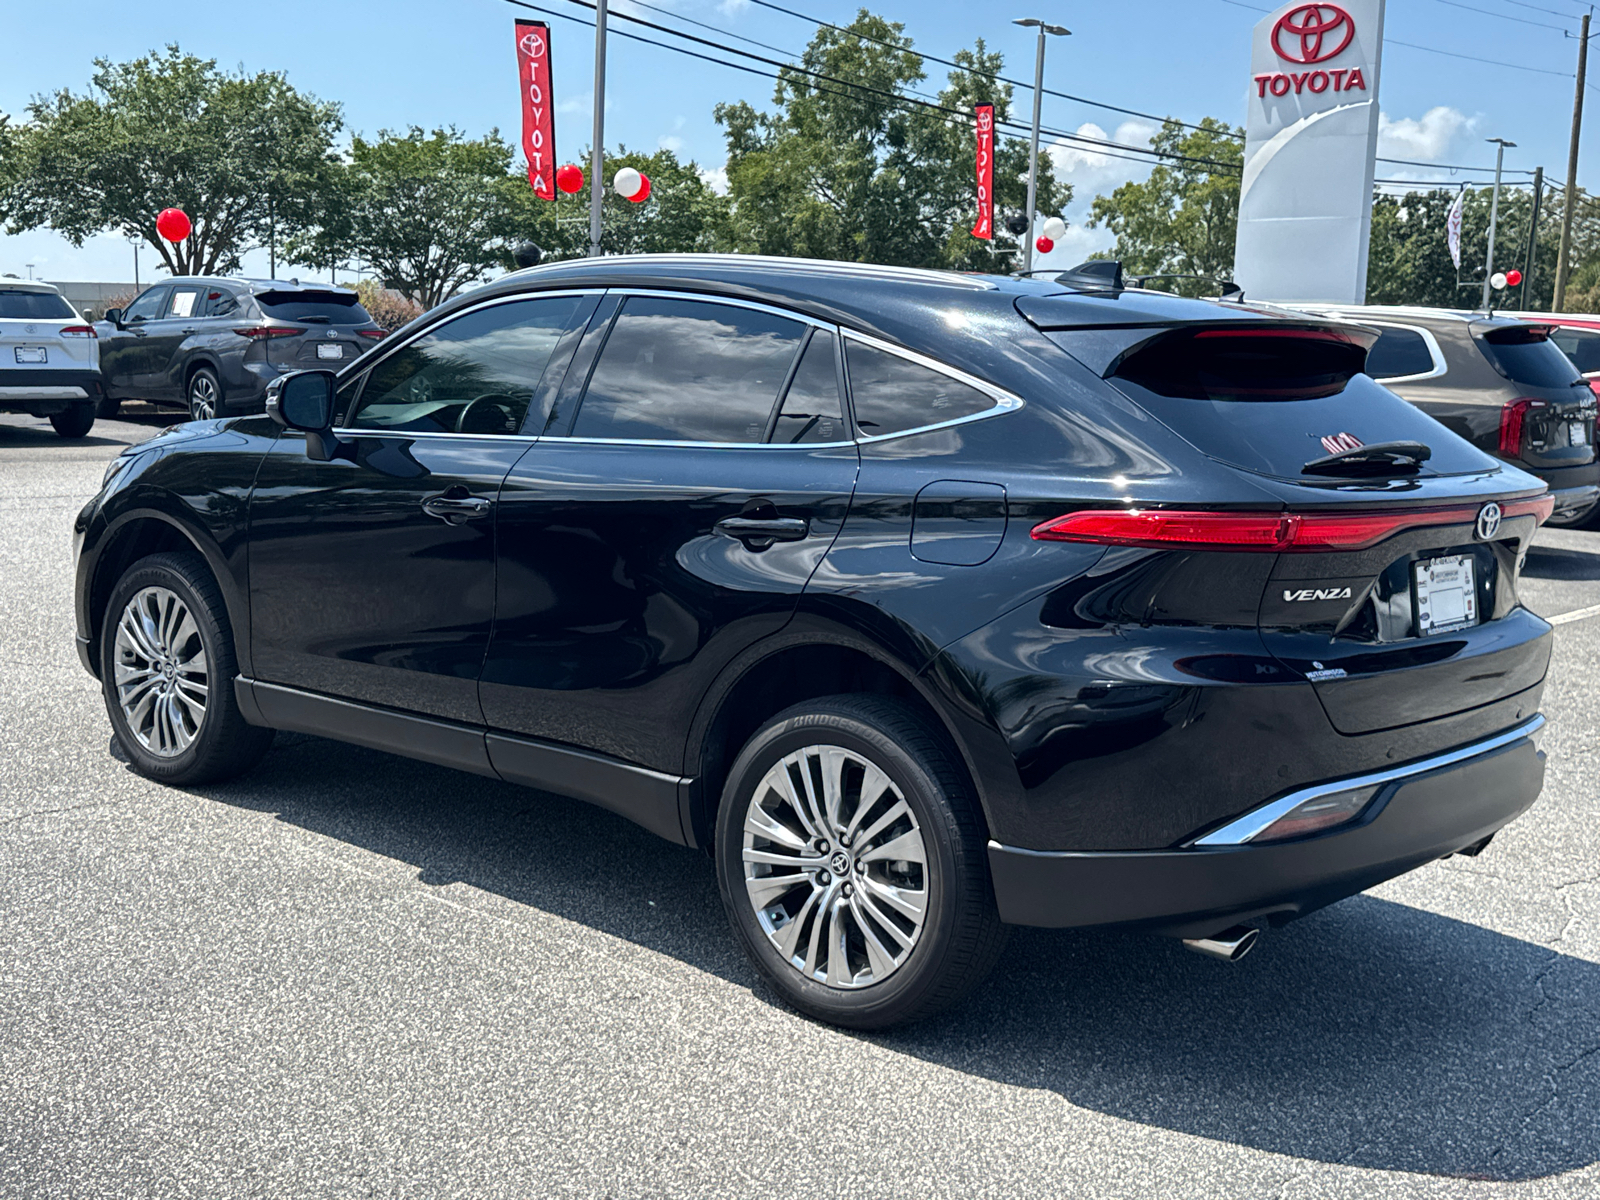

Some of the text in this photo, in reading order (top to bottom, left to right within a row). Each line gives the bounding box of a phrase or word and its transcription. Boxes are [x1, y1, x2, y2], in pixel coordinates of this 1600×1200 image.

[1254, 67, 1366, 98] TOYOTA
[530, 62, 547, 192] TOYOTA
[978, 134, 989, 233] TOYOTA
[1282, 587, 1352, 602] VENZA
[793, 714, 893, 751] BRIDGESTONE
